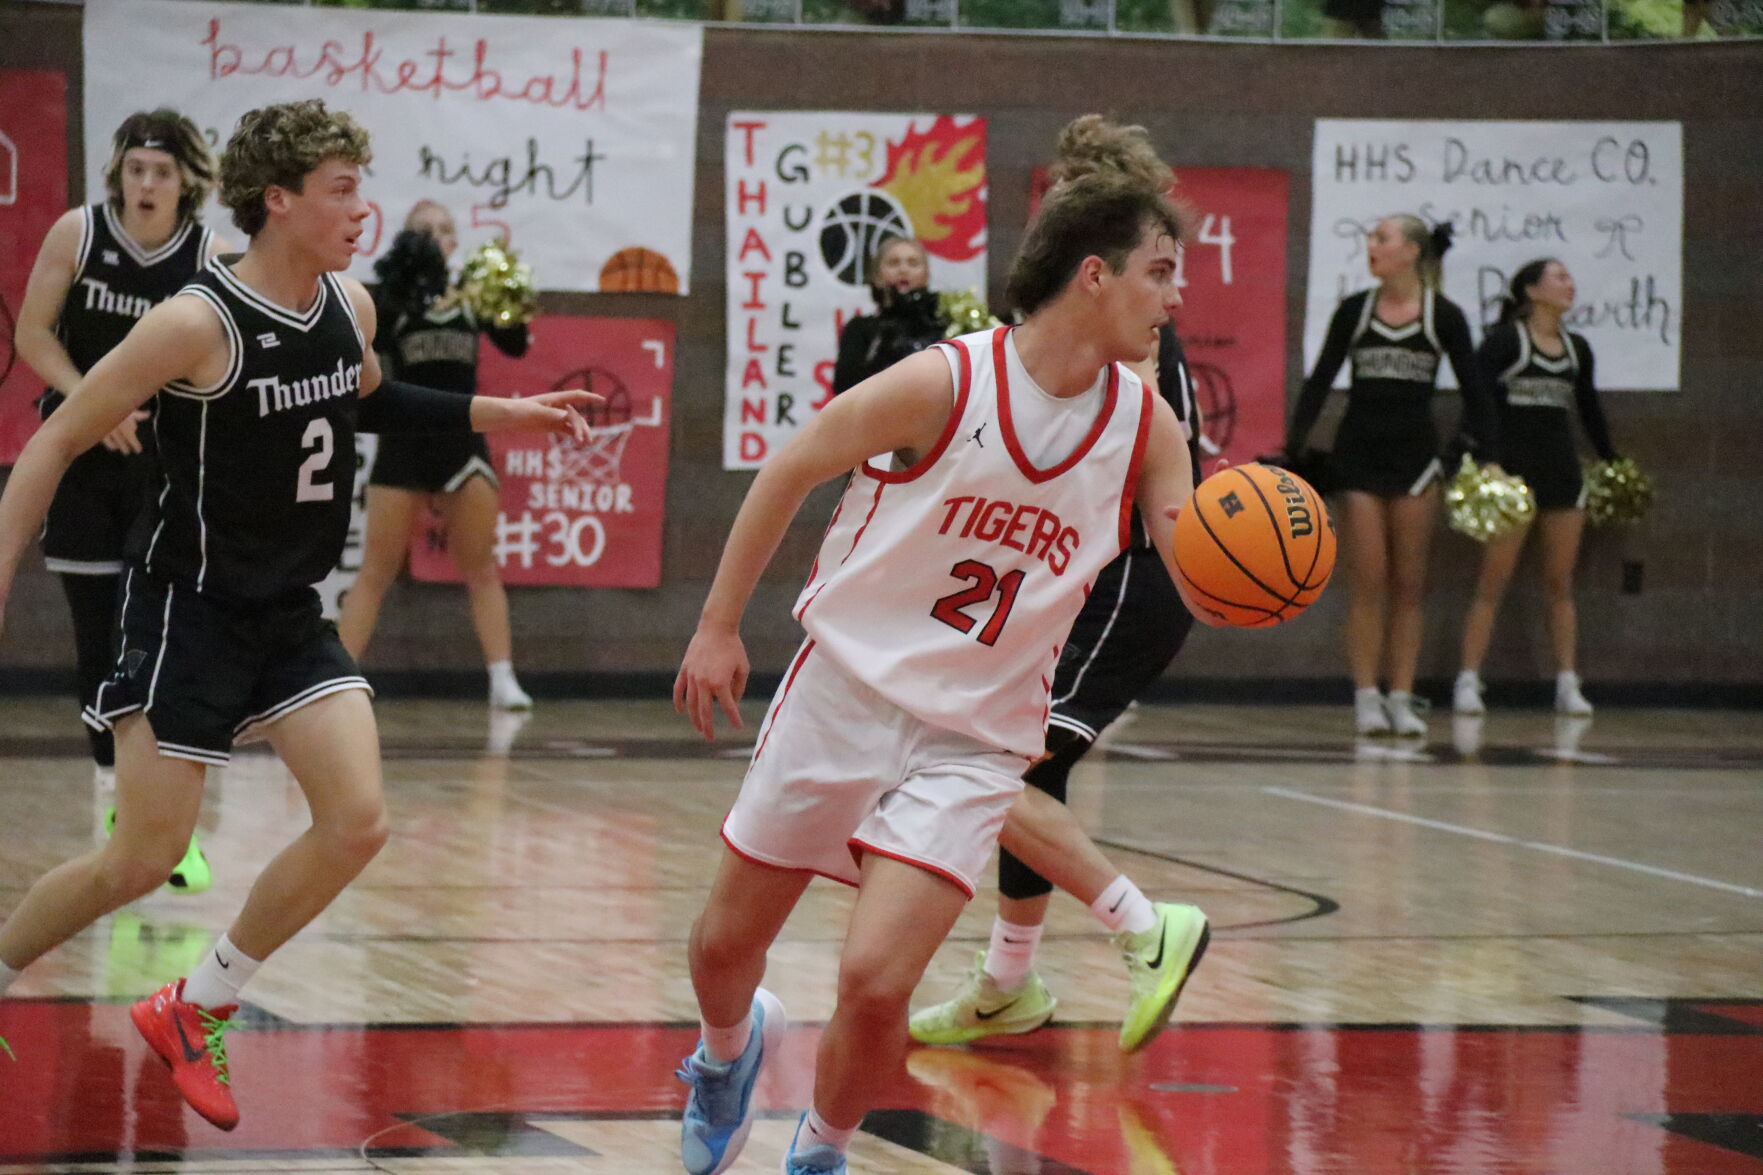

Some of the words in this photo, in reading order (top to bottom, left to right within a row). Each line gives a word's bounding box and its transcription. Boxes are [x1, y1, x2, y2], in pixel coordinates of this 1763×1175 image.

[202, 17, 609, 112] basketball
[418, 136, 606, 211] night
[814, 130, 875, 179] #3
[1334, 142, 1416, 184] HHS
[1443, 136, 1578, 186] Dance
[732, 121, 771, 463] THAILAND
[775, 143, 812, 427] GUBLER
[295, 416, 335, 503] 2
[505, 449, 563, 479] HHS
[527, 481, 635, 514] SENIOR
[492, 510, 606, 569] #30
[937, 495, 1081, 578] TIGERS
[929, 558, 1027, 648] 21
